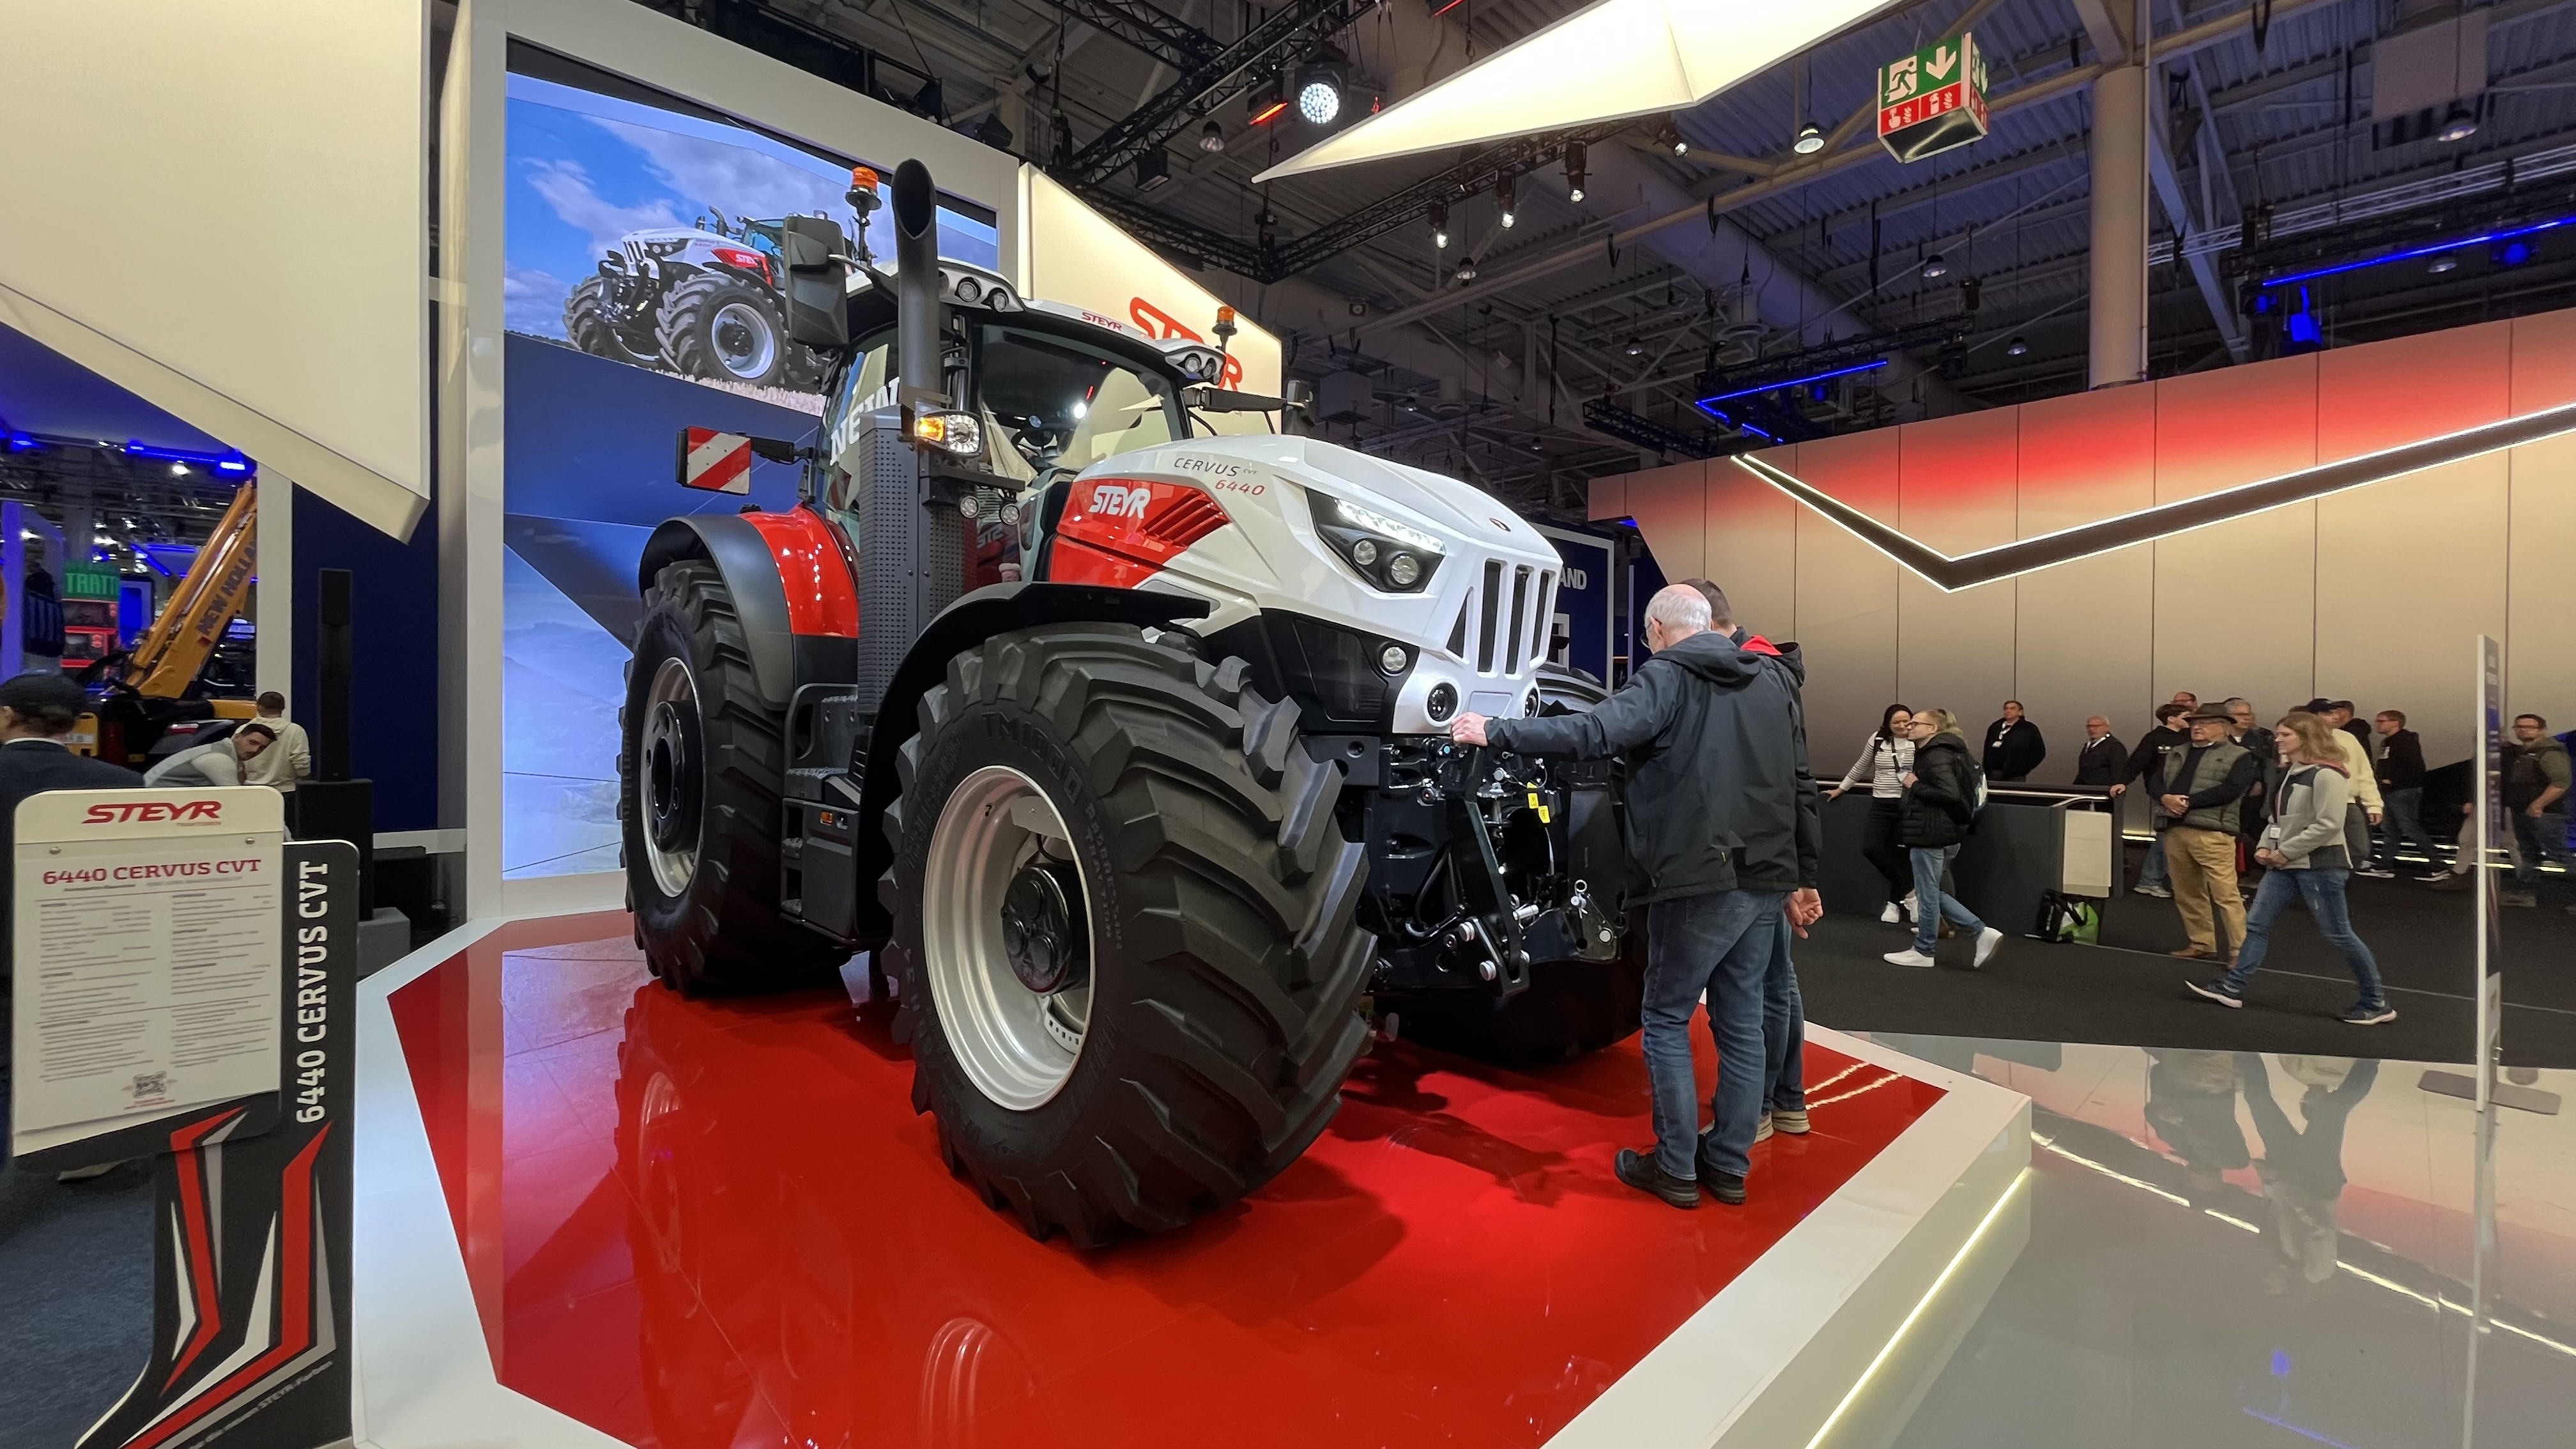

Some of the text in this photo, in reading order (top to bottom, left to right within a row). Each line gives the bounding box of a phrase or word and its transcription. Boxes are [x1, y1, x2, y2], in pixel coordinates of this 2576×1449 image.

[1081, 311, 1123, 332] STEYR
[1174, 457, 1241, 477] CERVUS
[1215, 479, 1266, 496] 6440
[1088, 485, 1151, 519] STEYR
[197, 594, 228, 636] NEW
[81, 801, 222, 824] STEYR
[42, 859, 262, 885] 6440 CERVUS CVT
[296, 861, 328, 1123] 6440 CERVUS CVT
